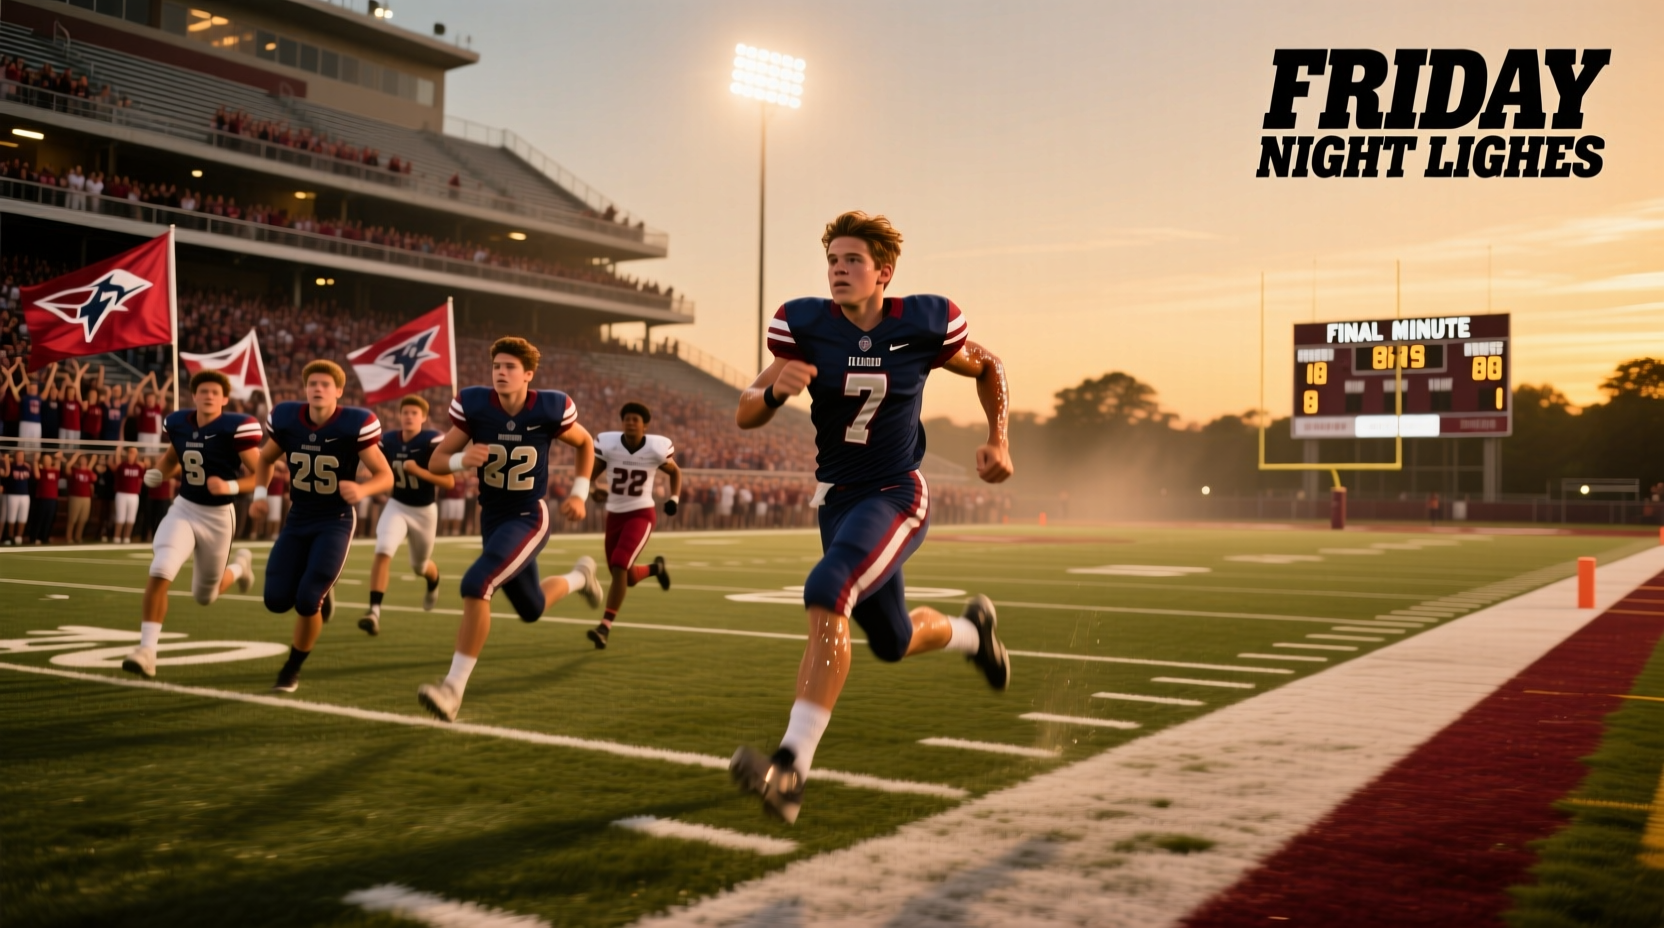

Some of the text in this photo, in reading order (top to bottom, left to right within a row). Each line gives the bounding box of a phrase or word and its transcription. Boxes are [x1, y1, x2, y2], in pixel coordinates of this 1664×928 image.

[1326, 316, 1471, 344] FINAL MINUTE
[843, 372, 888, 445] 7
[611, 467, 648, 497] 22
